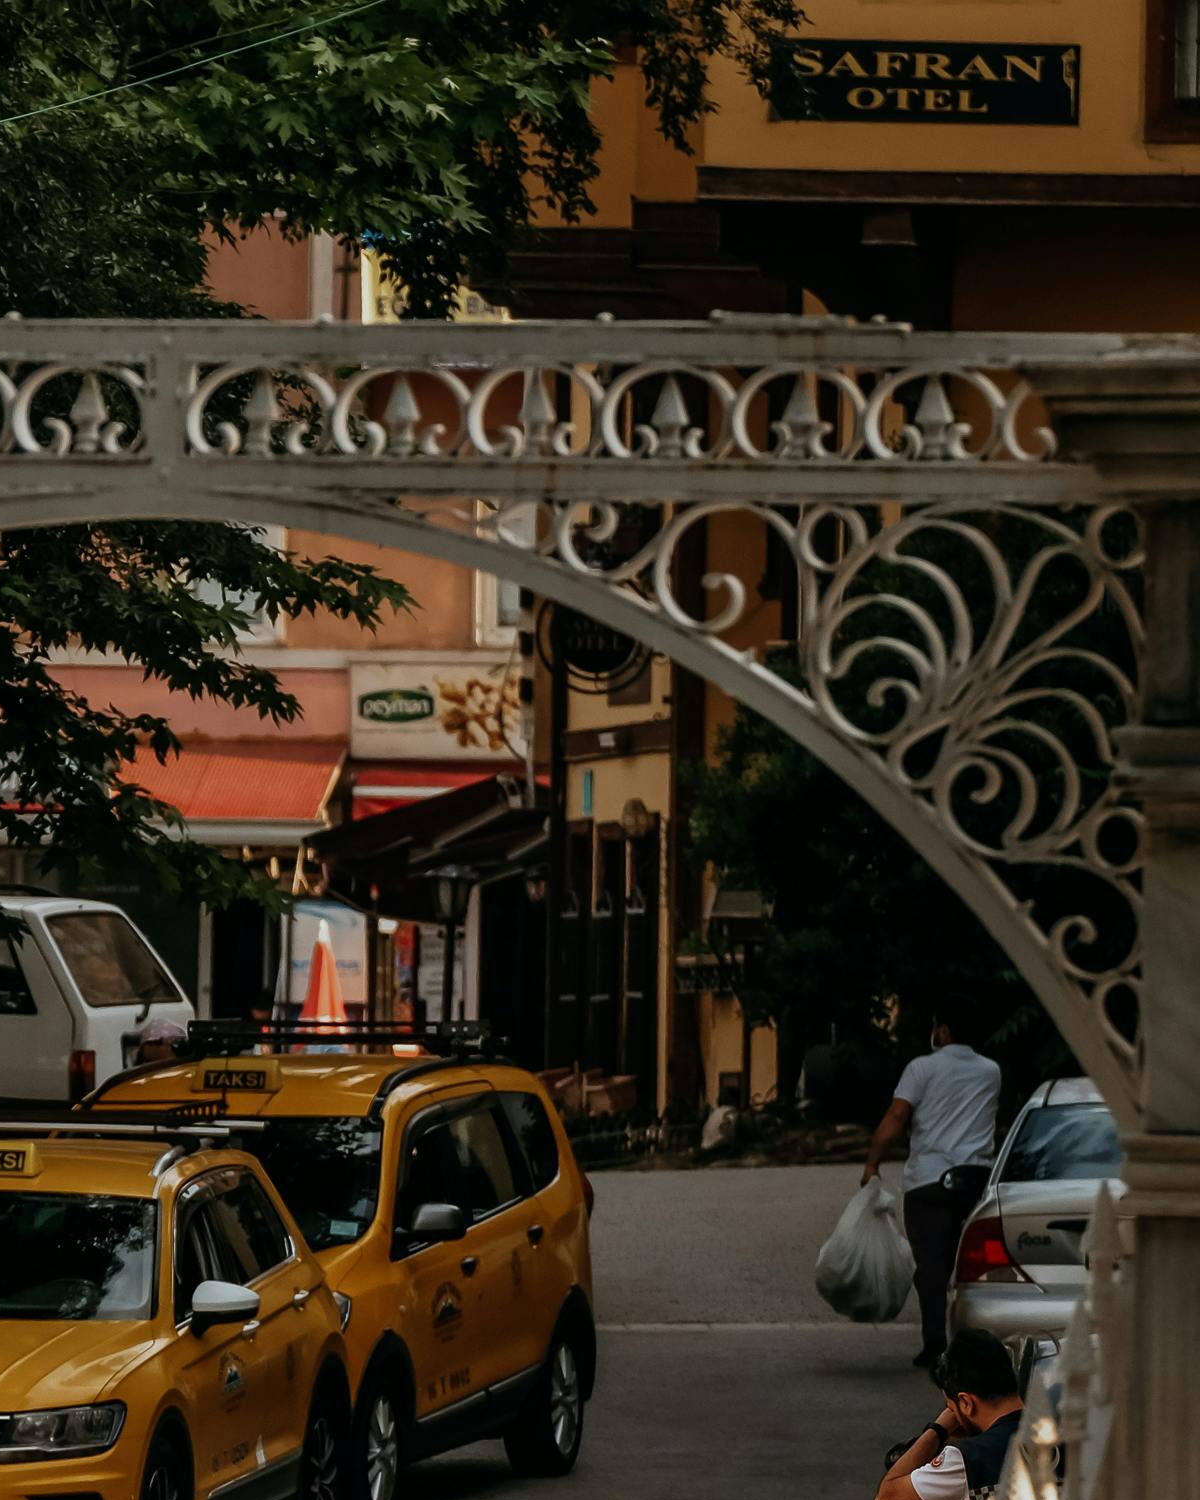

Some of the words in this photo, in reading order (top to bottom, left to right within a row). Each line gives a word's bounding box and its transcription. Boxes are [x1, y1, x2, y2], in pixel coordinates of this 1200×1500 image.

[792, 48, 1046, 82] SAFRAN
[846, 87, 990, 113] OTEL
[362, 697, 431, 717] peyman
